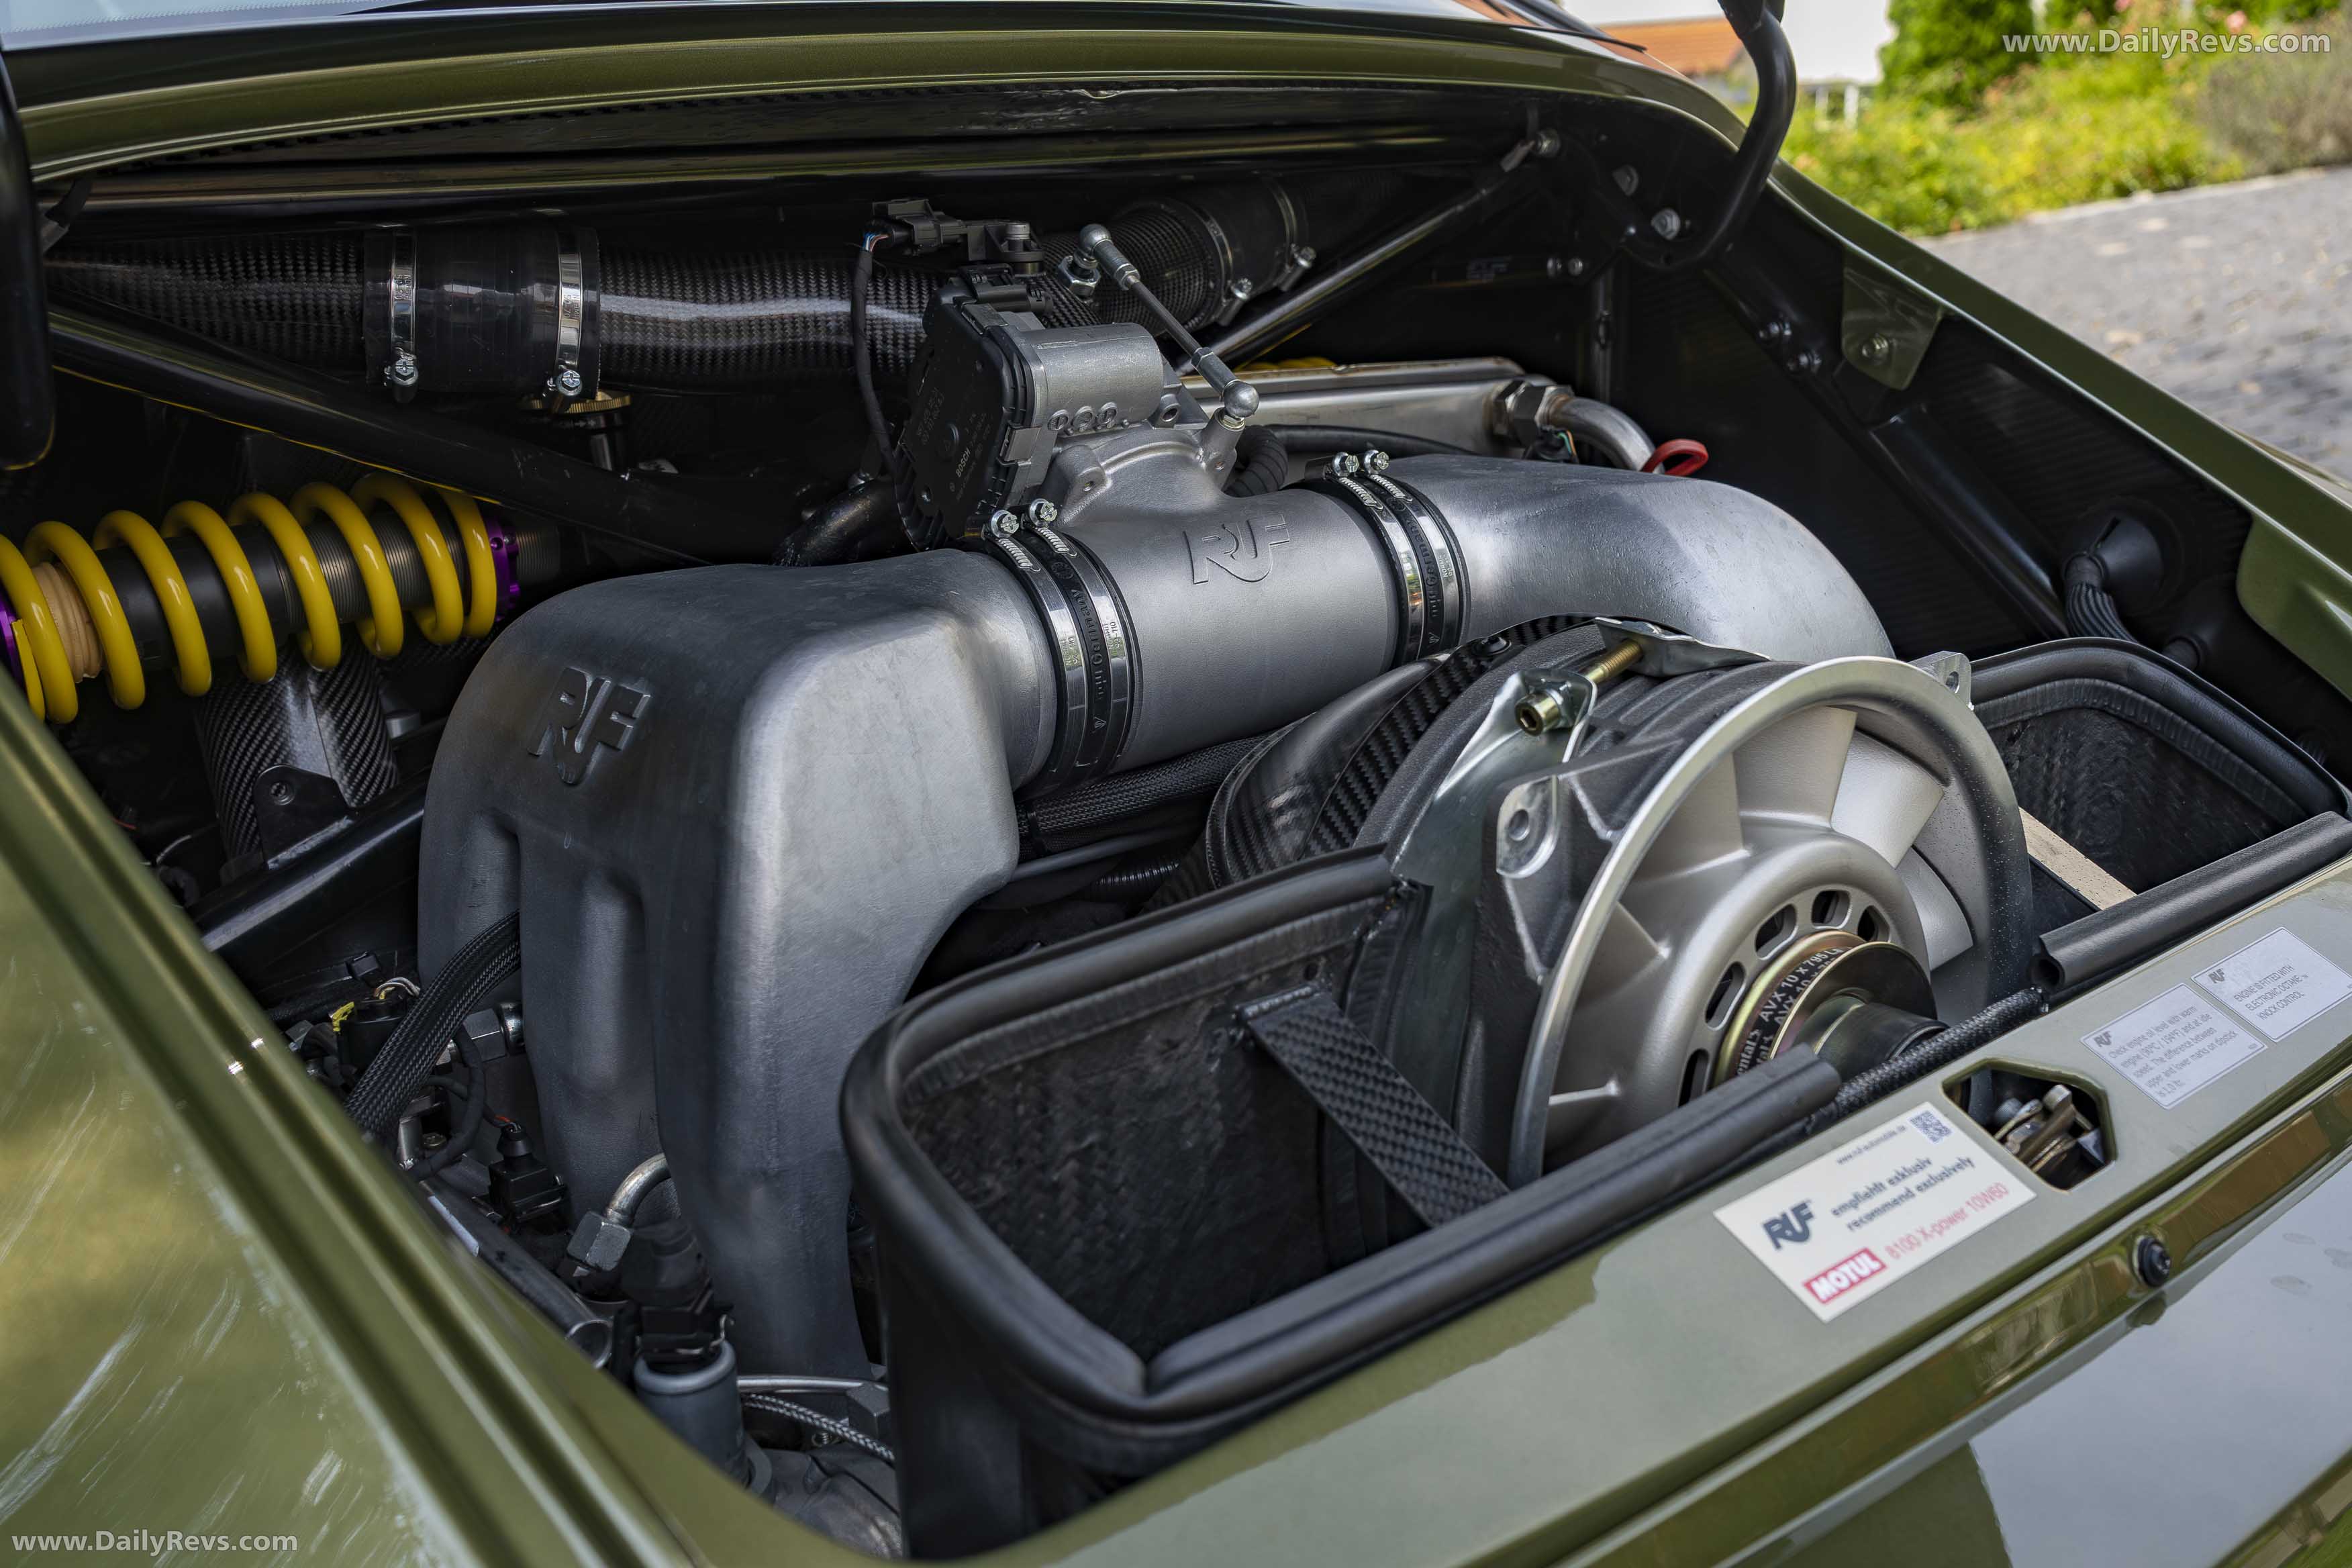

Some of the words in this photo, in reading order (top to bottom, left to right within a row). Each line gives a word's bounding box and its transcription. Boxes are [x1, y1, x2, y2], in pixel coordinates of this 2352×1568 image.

[955, 447, 971, 478] BOSCH
[1759, 991, 1786, 1022] AVX
[1781, 975, 1799, 987] 10
[1802, 953, 1828, 966] 795
[1831, 1182, 1887, 1217] empfiehlt
[1888, 1159, 1932, 1186] exklusiv
[1847, 1187, 1916, 1231] recommend
[1916, 1158, 1975, 1192] exclusively
[1763, 1202, 1814, 1250] RUF
[1885, 1234, 1921, 1259] 8100
[1916, 1208, 1968, 1240] X-power
[1965, 1183, 2008, 1211] 10W60
[1812, 1253, 1880, 1300] MOTUL
